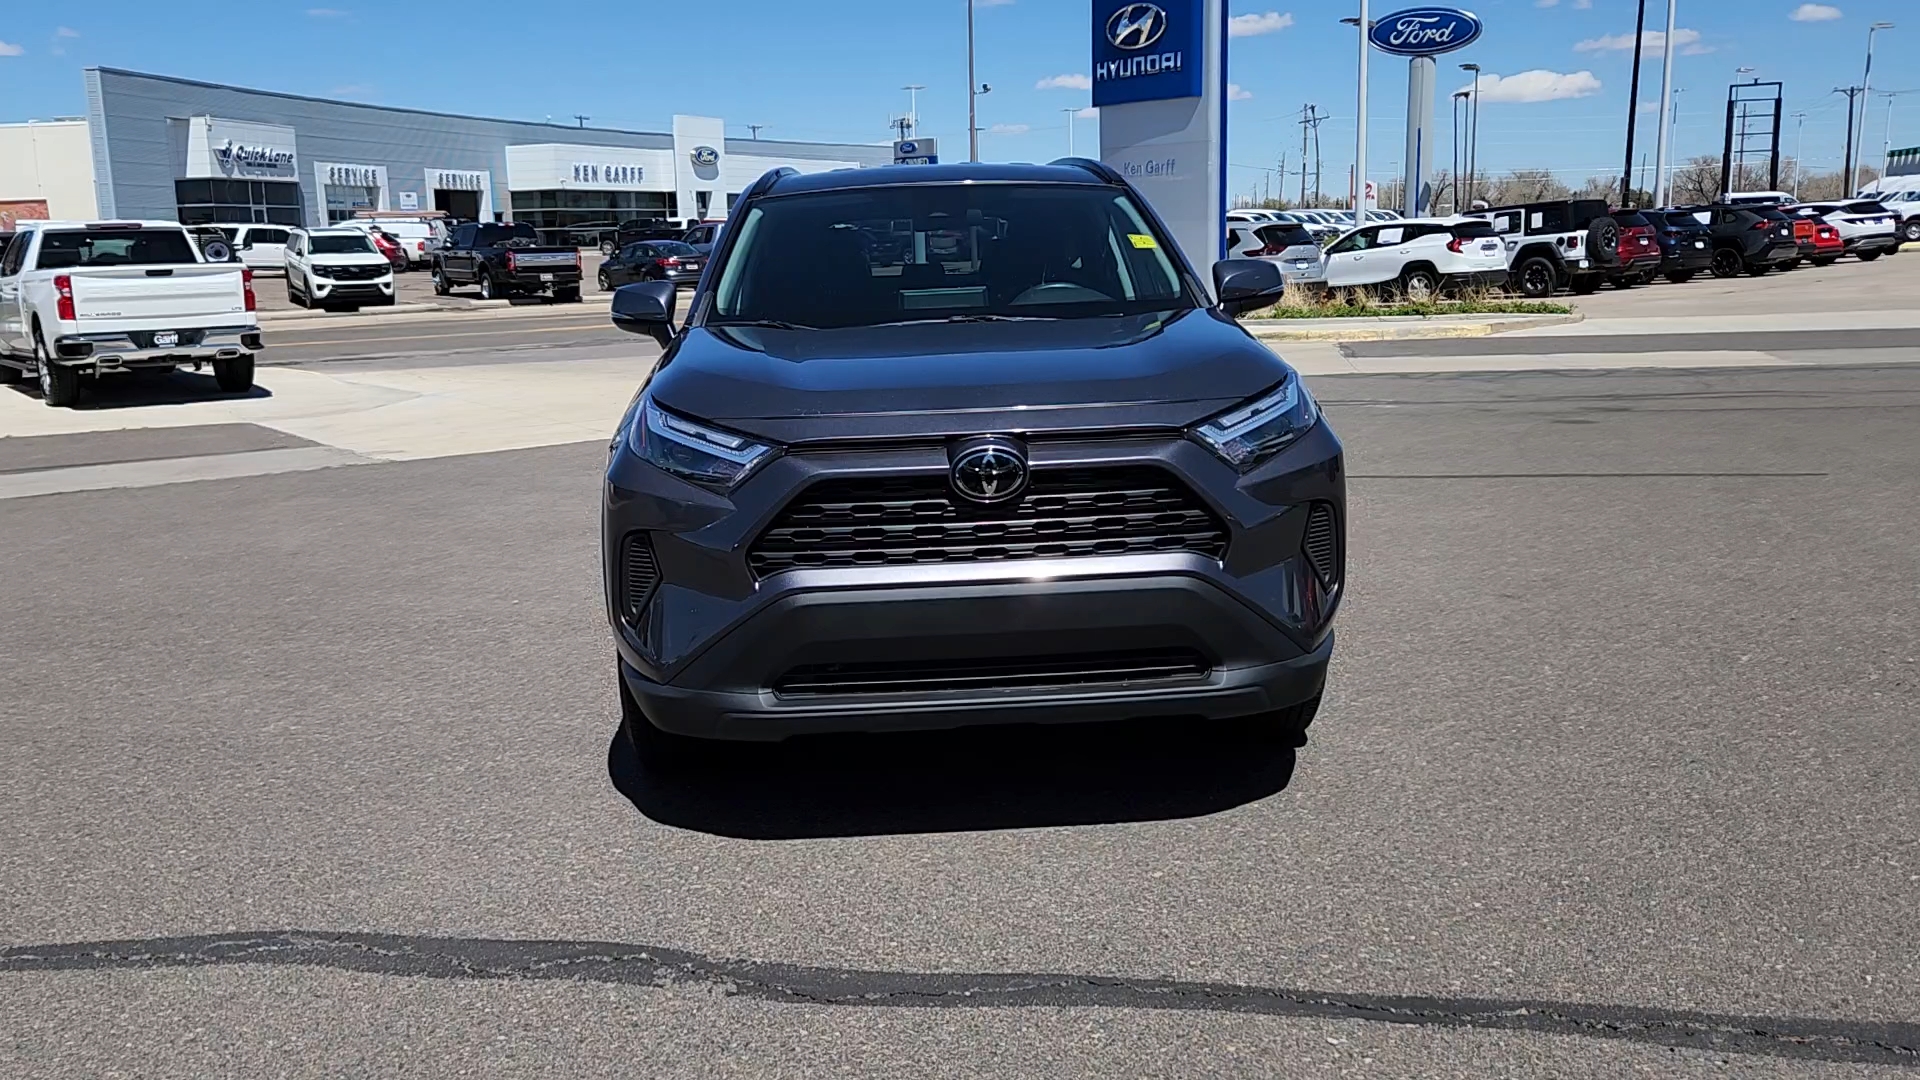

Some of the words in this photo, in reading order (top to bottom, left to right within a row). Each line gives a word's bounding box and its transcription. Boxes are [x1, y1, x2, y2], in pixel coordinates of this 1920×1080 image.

[1389, 17, 1457, 45] Ford
[1096, 51, 1182, 81] HYUNDAI
[329, 167, 377, 180] SERVICE
[574, 164, 599, 178] KEN
[605, 165, 644, 180] GARFF
[1123, 161, 1143, 175] Ken
[1145, 159, 1176, 175] Garff
[439, 173, 482, 184] SERVICE
